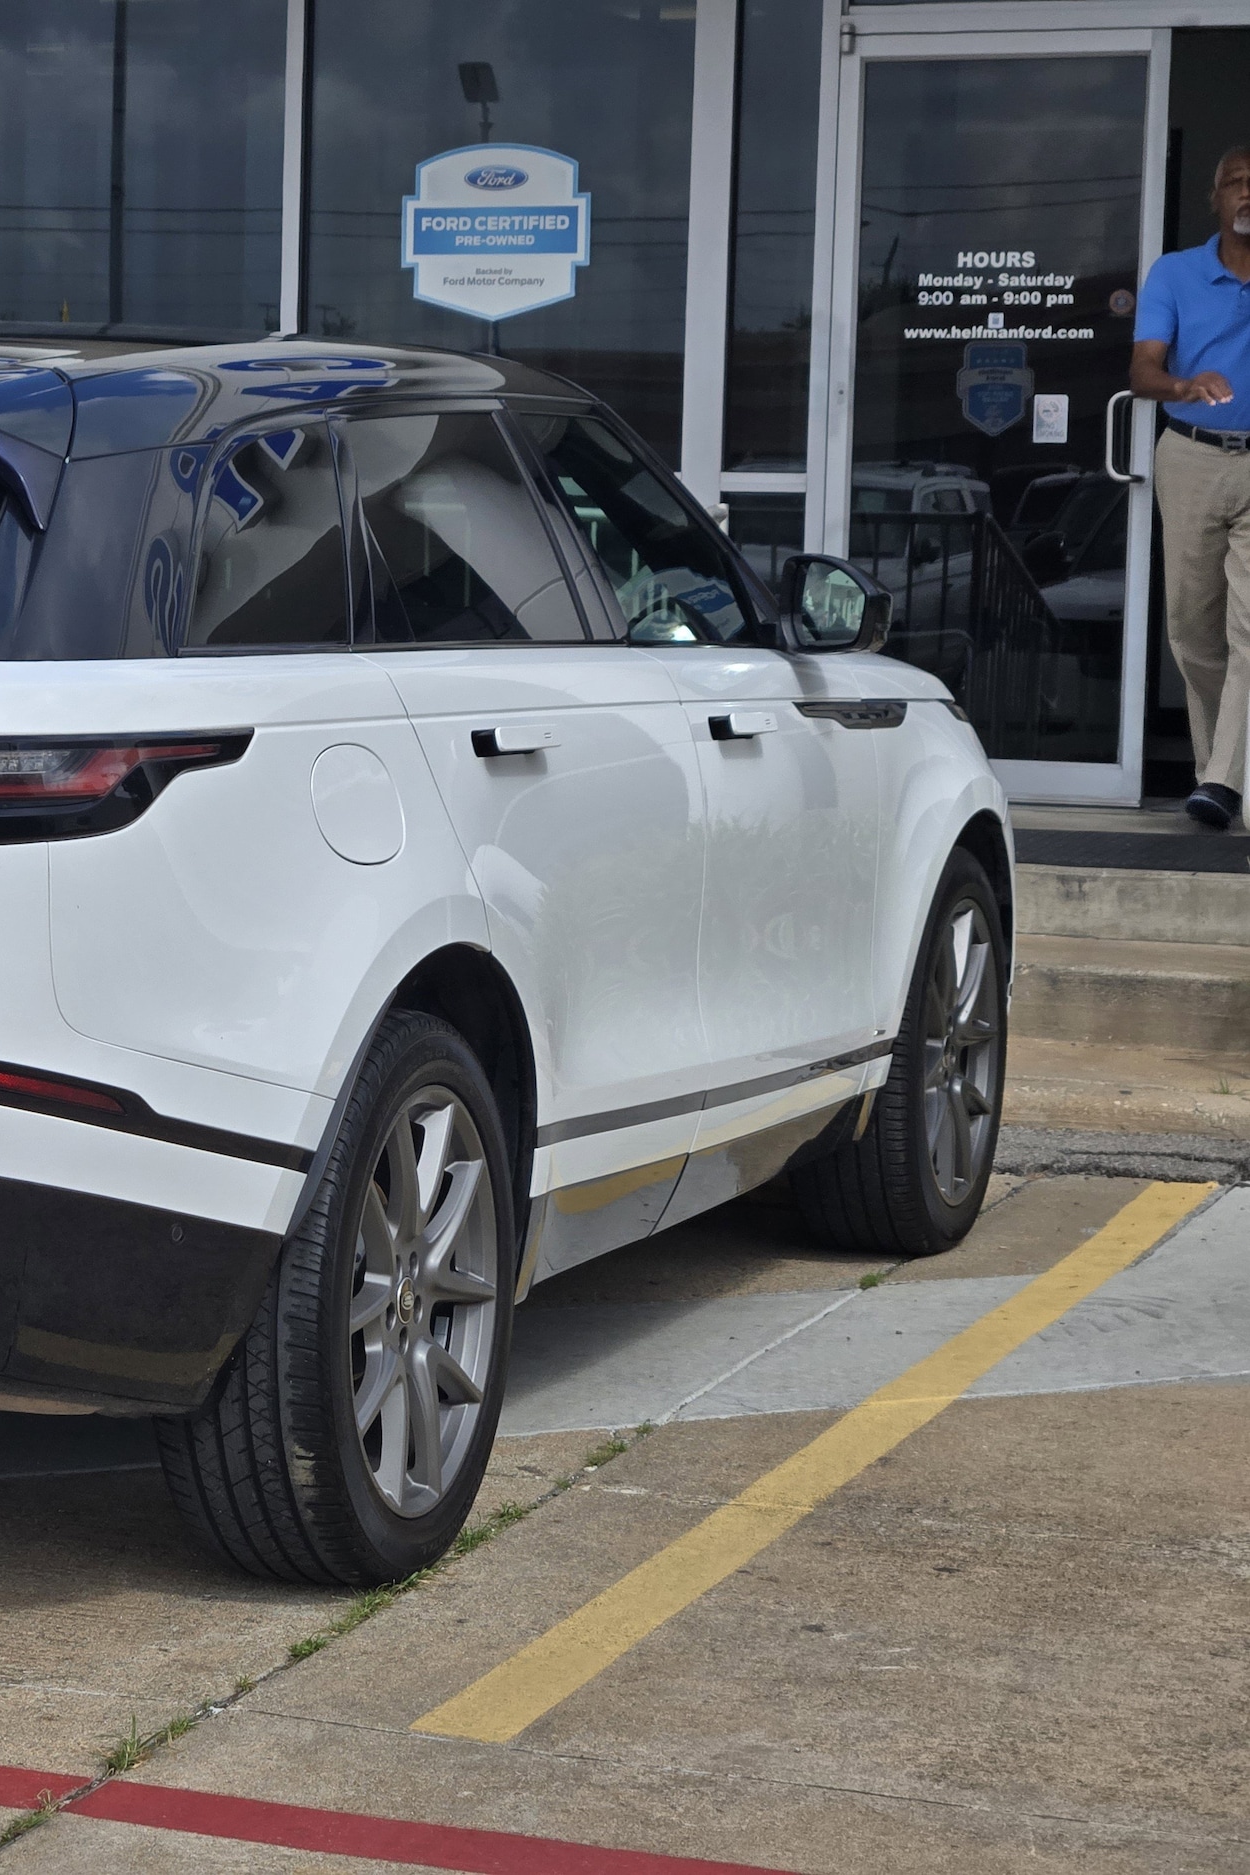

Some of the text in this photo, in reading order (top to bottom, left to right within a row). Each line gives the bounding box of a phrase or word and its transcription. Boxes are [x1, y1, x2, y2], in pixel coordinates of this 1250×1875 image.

[476, 167, 516, 187] Ford
[421, 215, 570, 231] FORD CERTIFIED
[455, 235, 535, 246] PRE-OWNED
[957, 250, 1036, 268] HOURS
[475, 267, 513, 276] Backed by
[443, 277, 545, 287] Ford Motor Company
[918, 273, 983, 289] Monday
[998, 273, 1074, 289] Saturday
[918, 291, 954, 305] 9:00
[960, 293, 987, 305] am
[1003, 291, 1041, 305] 9:00
[1046, 293, 1074, 307] pm
[904, 325, 1094, 339] www.helfmanford.com
